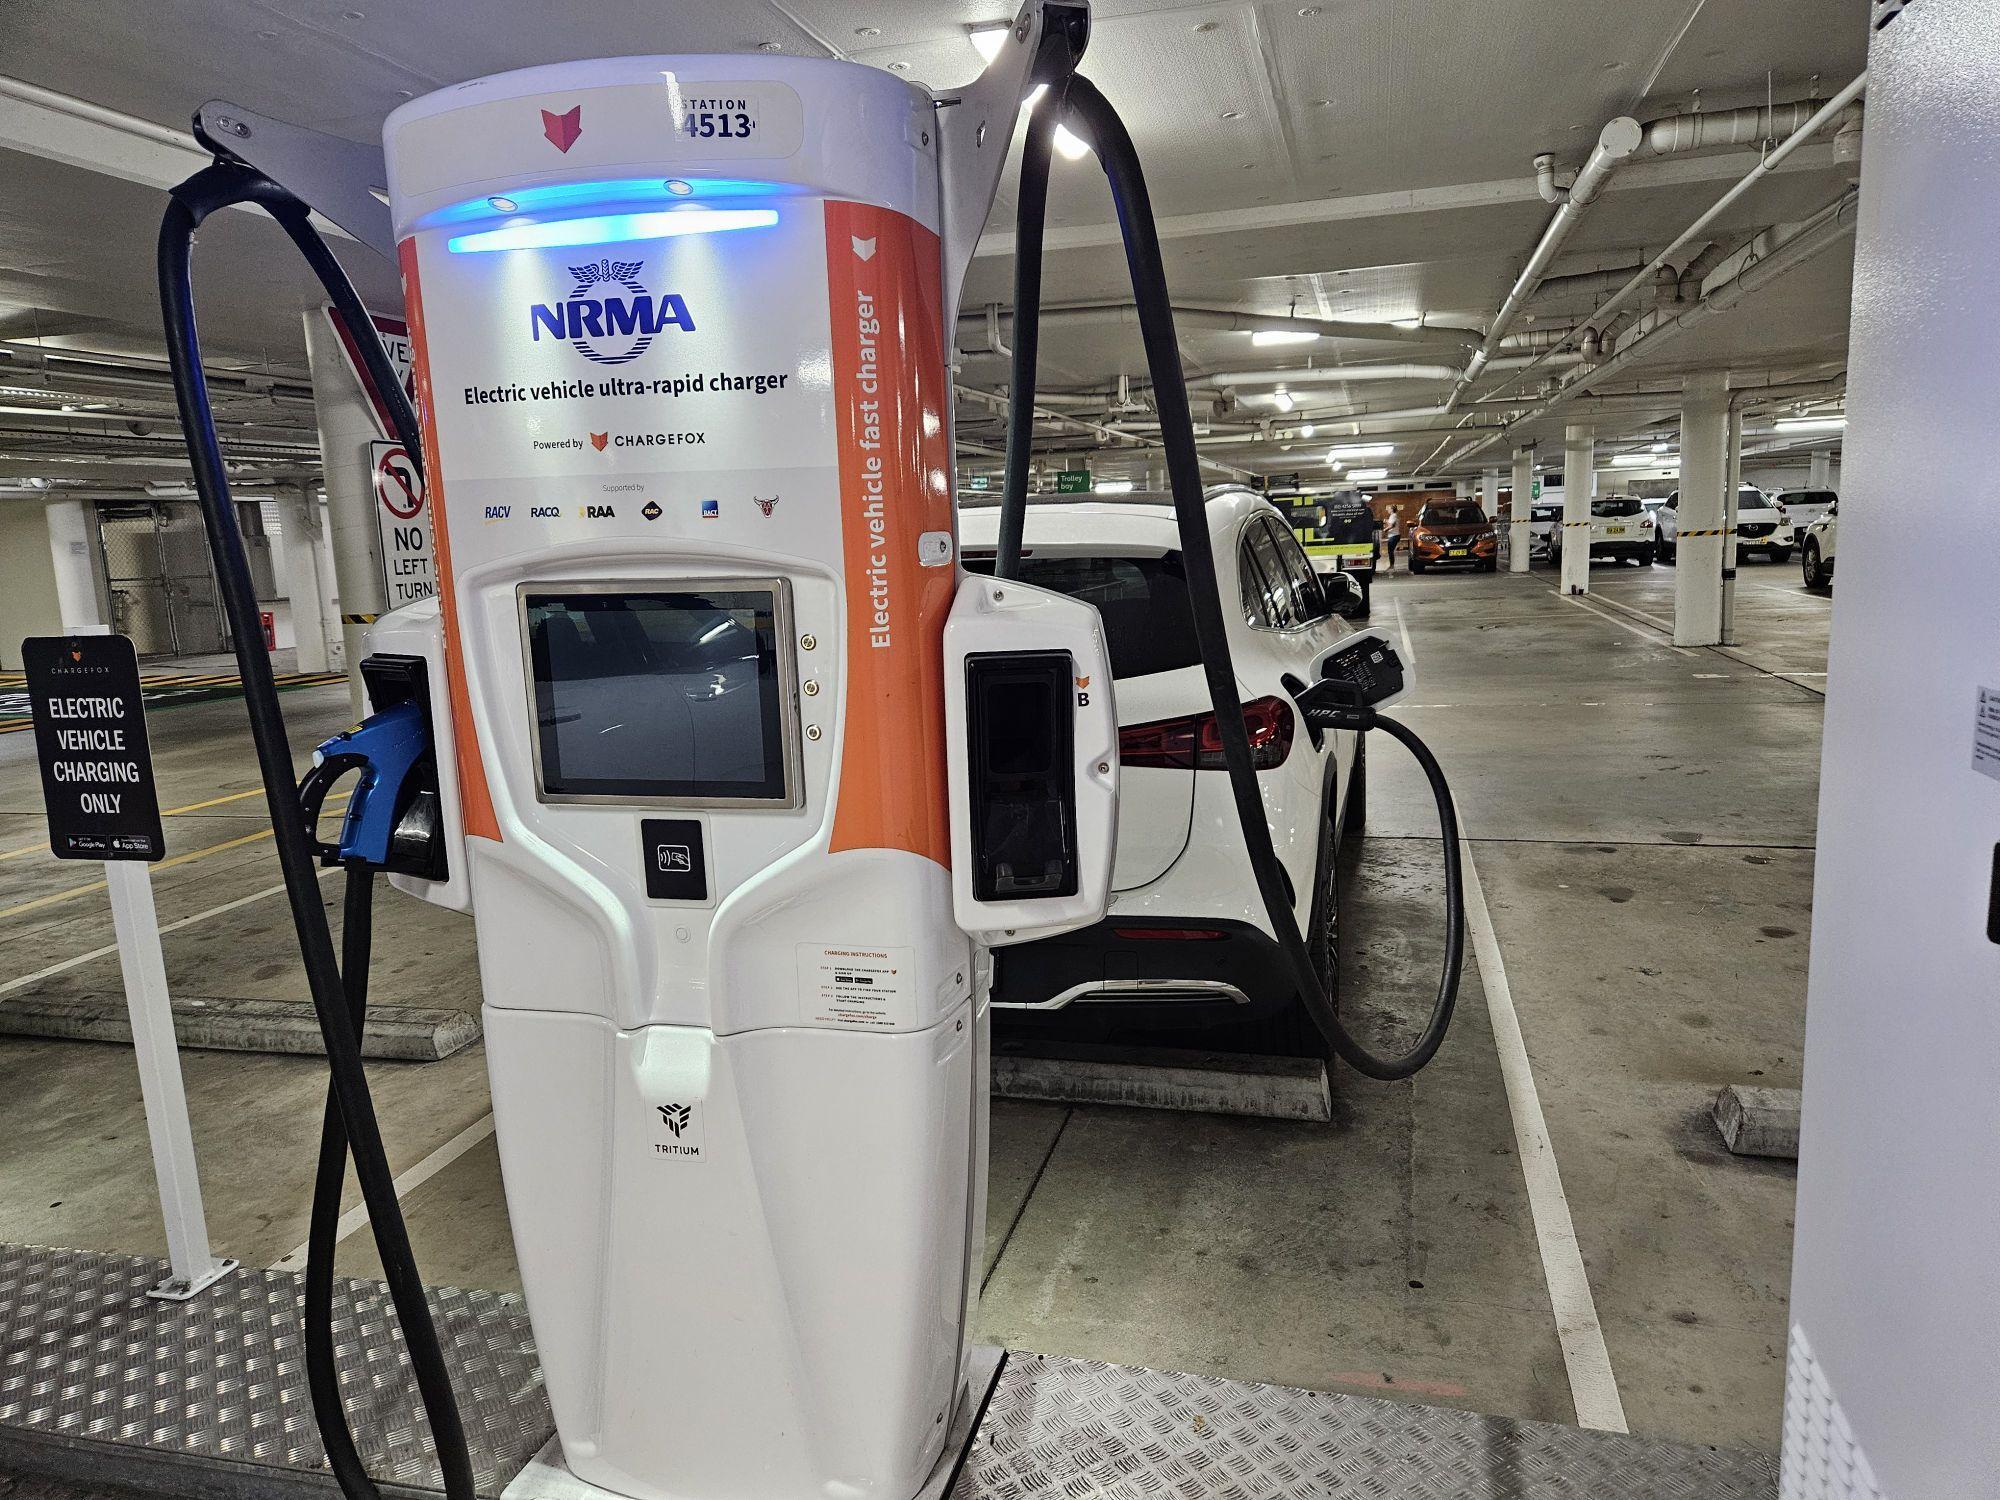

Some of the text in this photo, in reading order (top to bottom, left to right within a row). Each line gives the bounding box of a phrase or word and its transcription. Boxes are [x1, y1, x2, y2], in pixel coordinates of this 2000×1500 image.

[684, 113, 751, 138] 4513
[530, 293, 696, 344] NRMA
[464, 372, 788, 406] Electric vehicle ultra-rapid charger
[533, 437, 583, 451] Powered by
[614, 432, 706, 447] CHARGEFOX
[856, 290, 892, 649] Electric vehicle fast charger
[1060, 475, 1083, 483] Trolley
[602, 482, 645, 494] Supported by
[485, 506, 511, 518] RACV
[530, 507, 560, 518] RACQ
[587, 506, 615, 518] RAA
[394, 526, 423, 551] NO
[393, 558, 428, 576] LEFT
[395, 581, 433, 600] TURN
[51, 666, 110, 675] CHARGEFOX
[1077, 692, 1090, 707] B
[49, 697, 125, 719] ELECTRIC
[1306, 708, 1341, 718] HPC
[57, 729, 126, 751] VEHICLE
[53, 761, 140, 783] CHARGING
[80, 793, 121, 814] ONLY
[79, 841, 95, 849] Google
[122, 842, 134, 850] App
[850, 951, 888, 959] INSTRUCTIONS
[654, 1144, 699, 1155] TRITIUM
